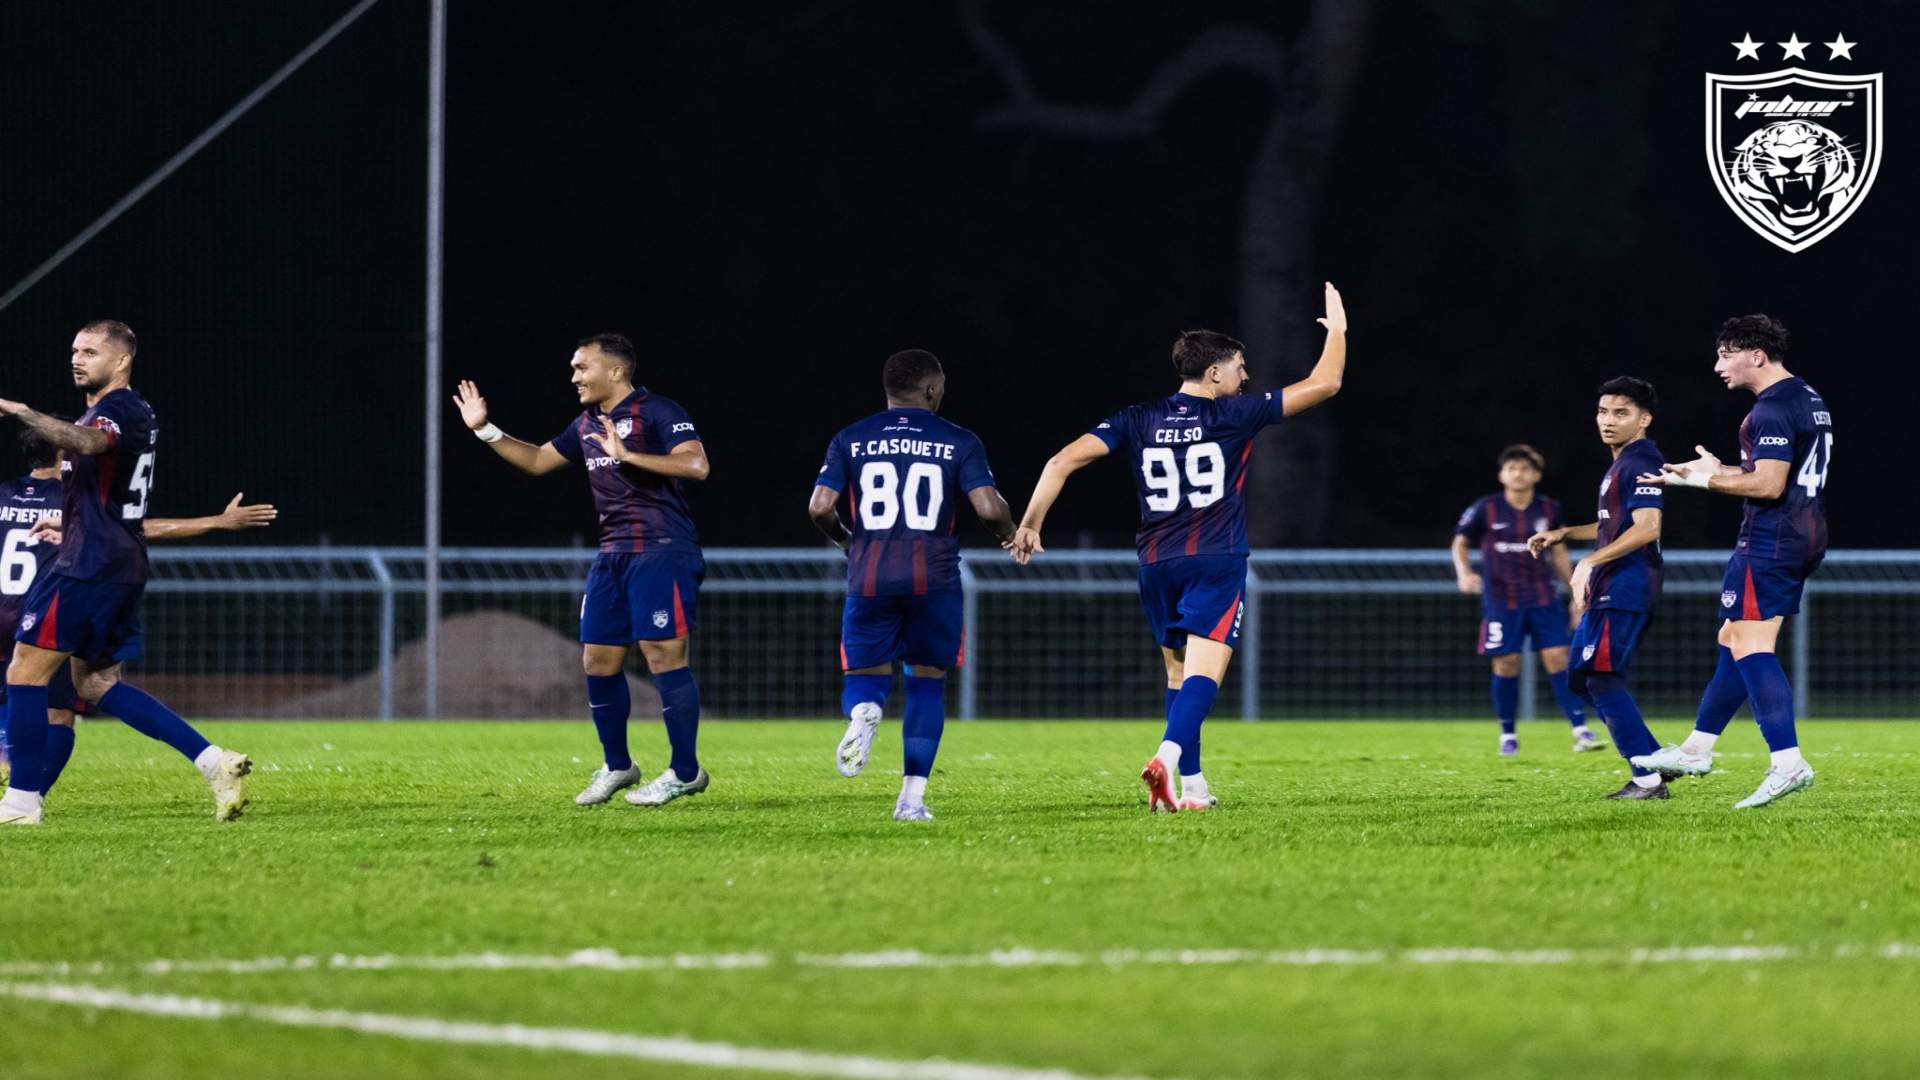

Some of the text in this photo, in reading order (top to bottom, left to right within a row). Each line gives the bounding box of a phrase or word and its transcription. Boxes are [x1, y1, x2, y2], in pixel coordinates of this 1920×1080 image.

[1155, 426, 1202, 443] CELSO
[1758, 436, 1789, 446] JCORP
[851, 438, 955, 460] F.CASQUETE
[122, 451, 156, 519] 5
[1141, 441, 1226, 512] 99
[859, 461, 945, 531] 80
[1634, 486, 1663, 496] JCORP
[0, 528, 40, 595] 6
[1488, 621, 1504, 642] 5
